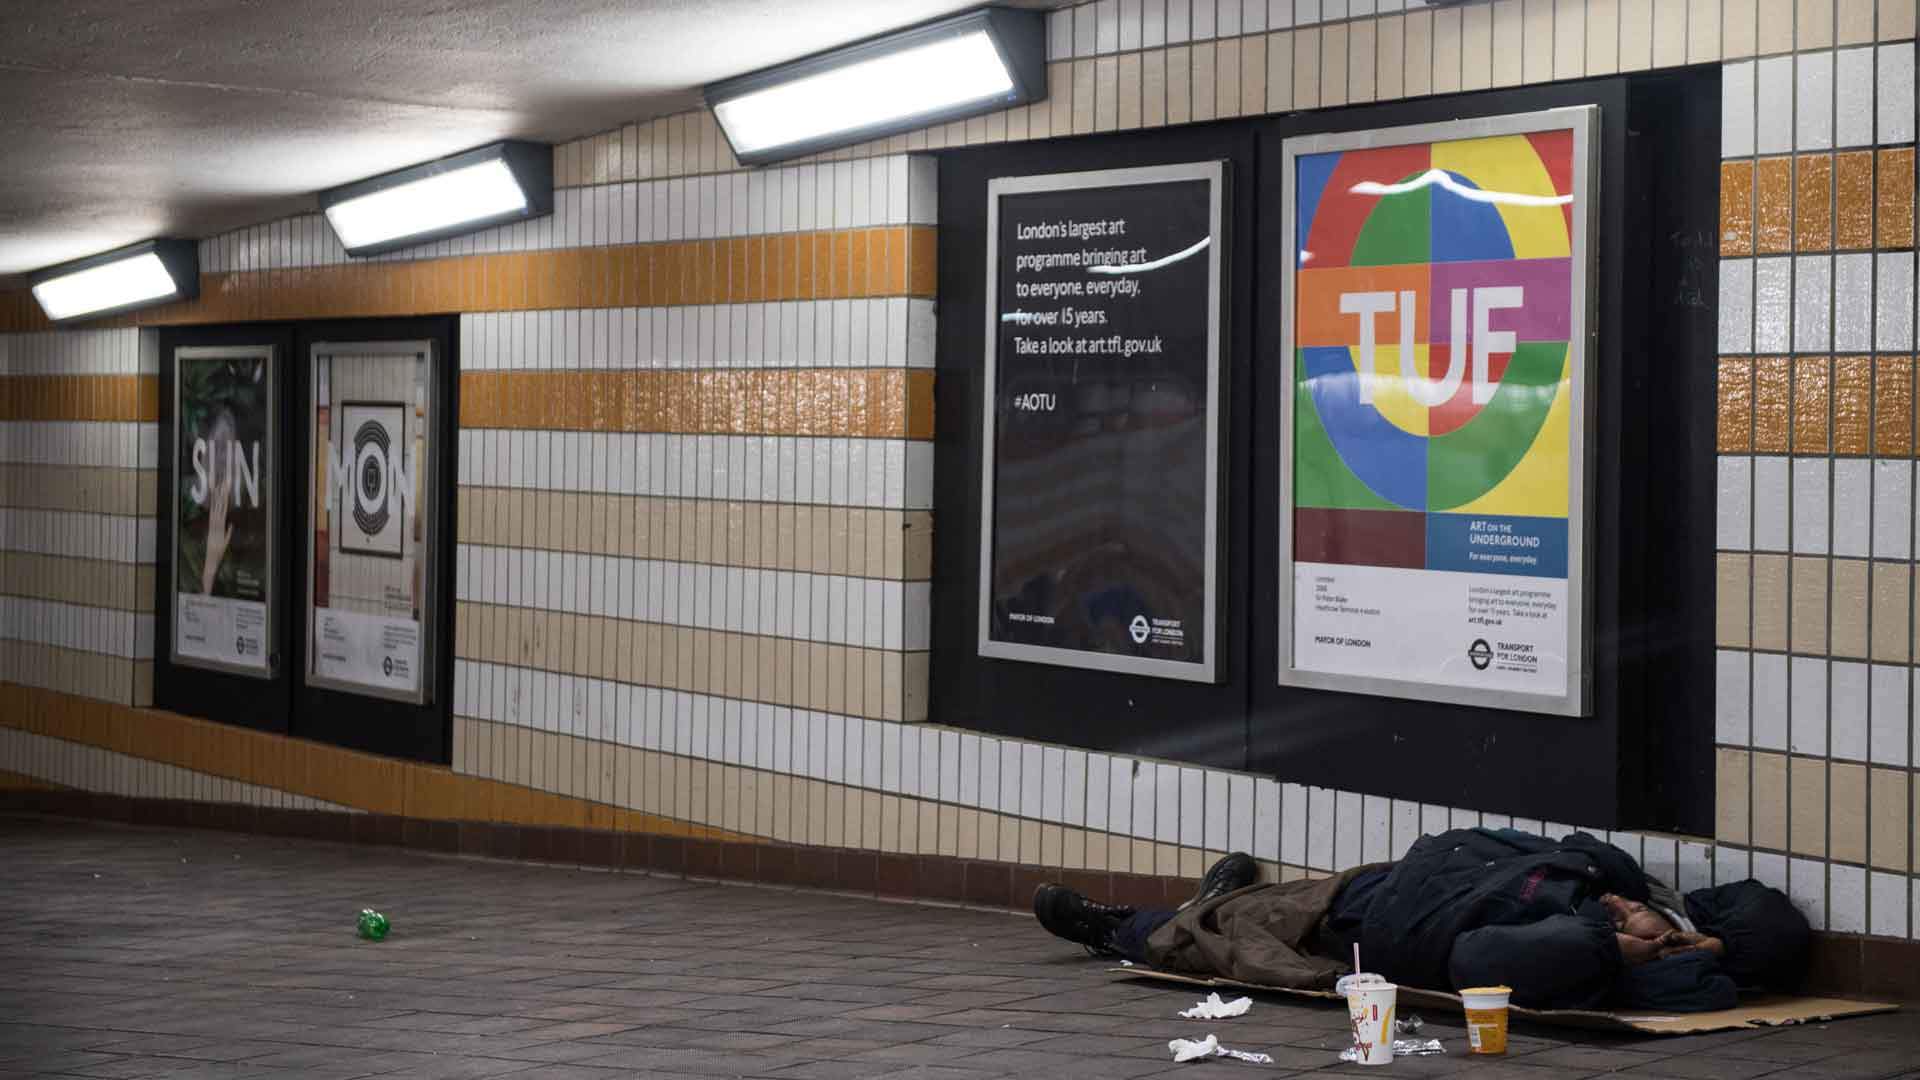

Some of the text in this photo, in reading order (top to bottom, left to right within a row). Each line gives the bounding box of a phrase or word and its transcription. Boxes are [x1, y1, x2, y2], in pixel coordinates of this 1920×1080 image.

[1017, 218, 1126, 240] London's largest art
[1016, 247, 1147, 273] programme bringing art
[1016, 281, 1030, 297] to
[1015, 307, 1108, 329] for over 15 years.
[1014, 335, 1162, 357] Take a look at art.tfl.gov.uk
[1014, 393, 1056, 411] #AOTU
[191, 437, 260, 509] SUN
[326, 440, 416, 513] MON
[1470, 520, 1513, 534] ART ON THE
[1470, 534, 1541, 548] UNDERGROUND
[1336, 637, 1344, 645] OF
[1345, 638, 1371, 648] LONDON
[1497, 642, 1534, 652] TRANSPORT
[1496, 652, 1509, 661] FOR
[1510, 654, 1538, 664] LONDON
